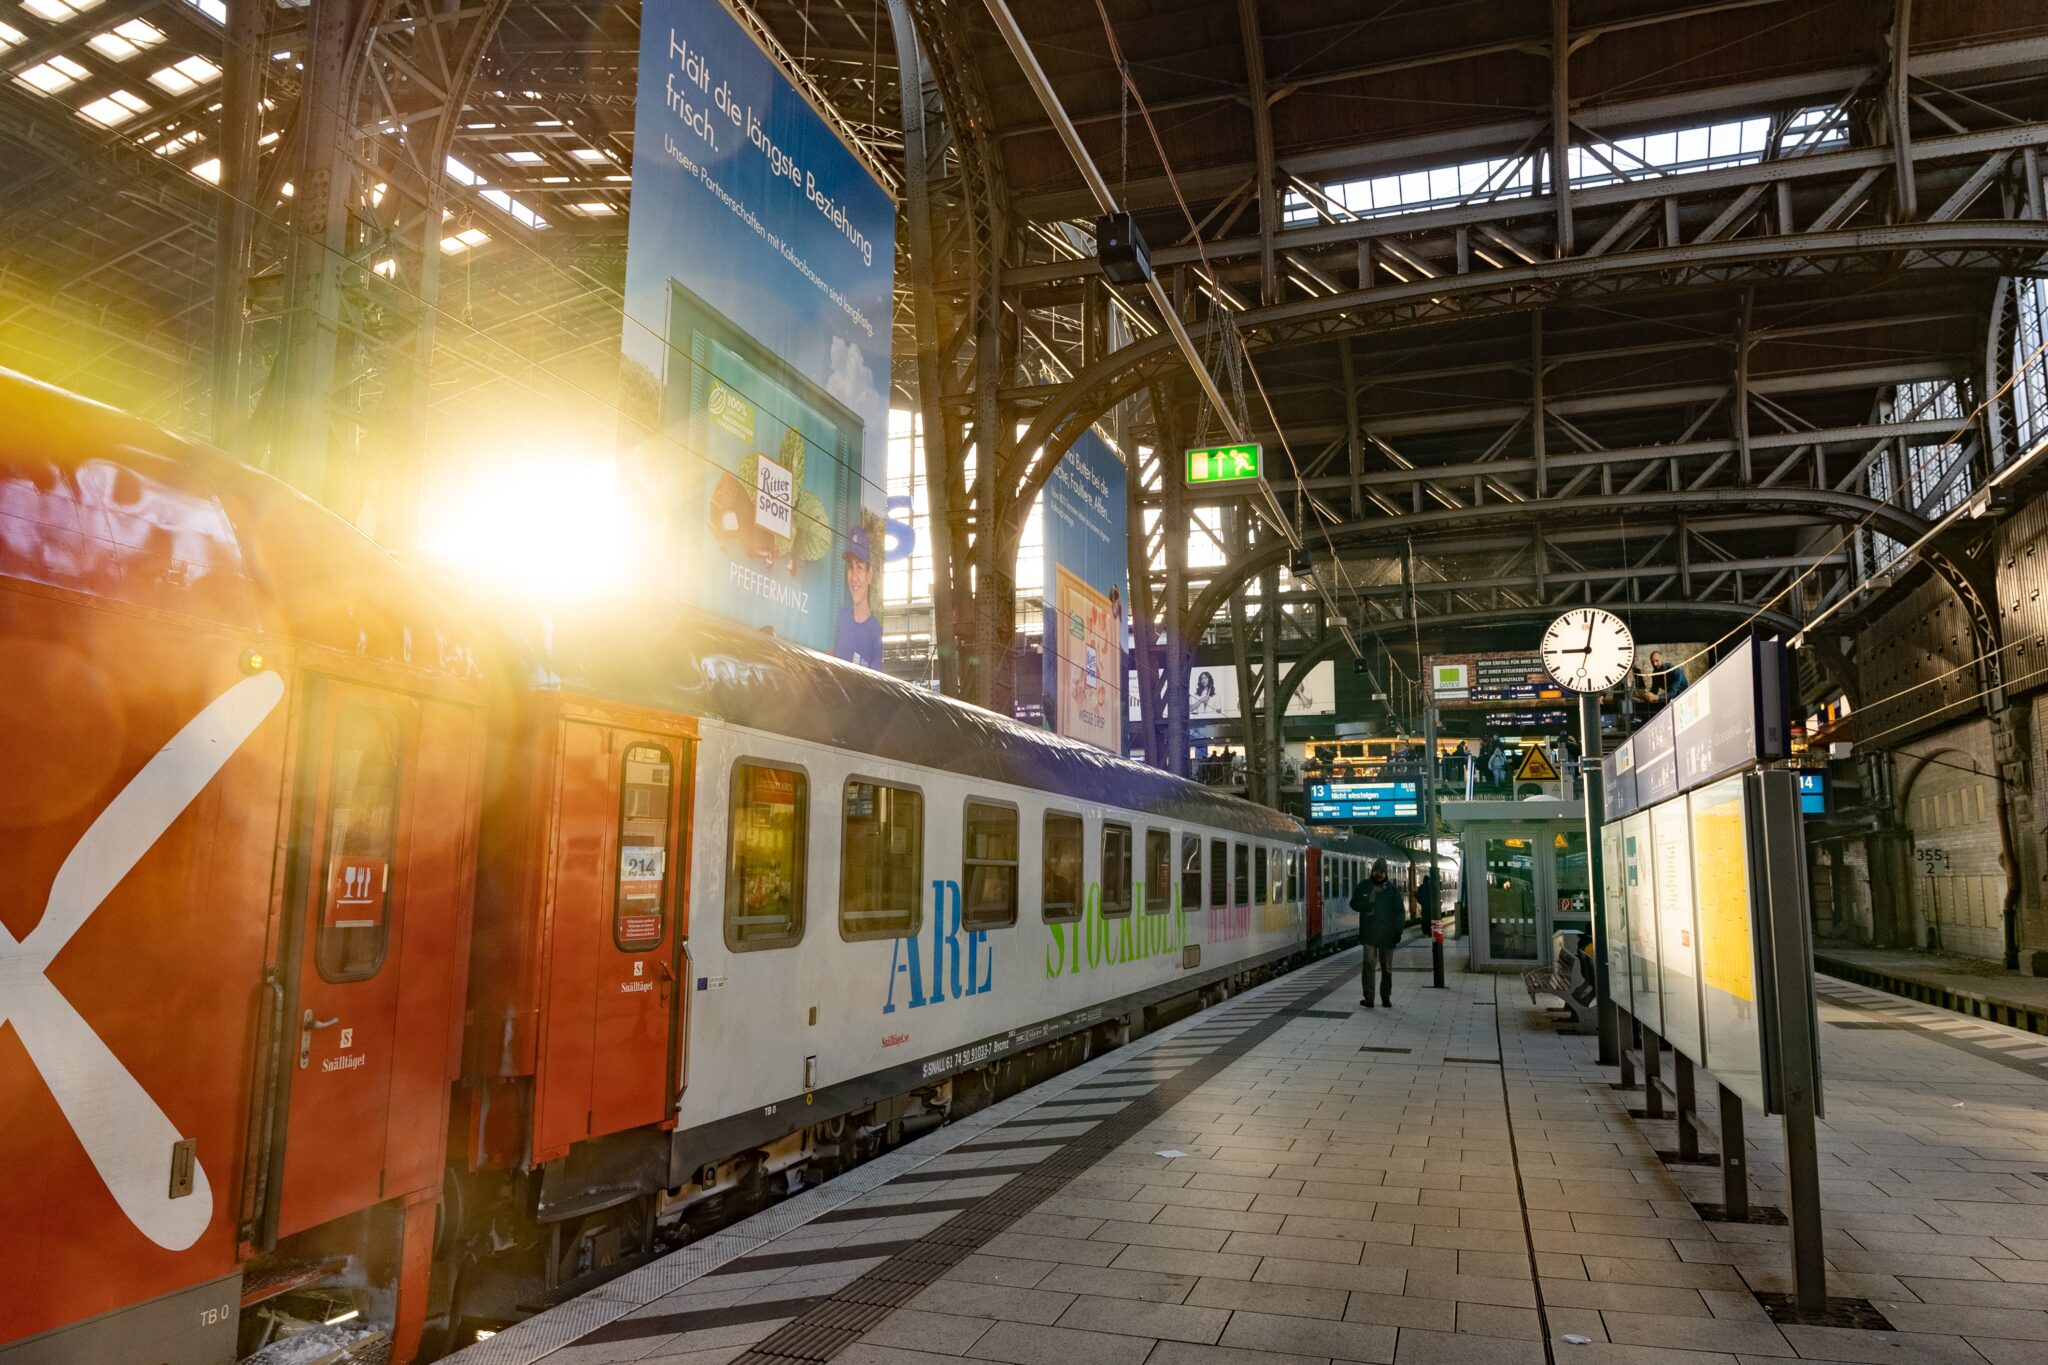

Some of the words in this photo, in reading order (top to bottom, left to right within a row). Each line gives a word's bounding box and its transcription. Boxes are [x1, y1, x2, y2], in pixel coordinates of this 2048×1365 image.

[666, 73, 719, 152] frisch.
[669, 27, 710, 94] Hält
[714, 80, 742, 126] die
[746, 106, 802, 187] längste
[806, 170, 873, 267] Beziehung
[664, 133, 699, 177] Unsere
[701, 167, 766, 239] Partnerschaften
[767, 233, 780, 250] mit
[780, 240, 829, 294] Kakaobauern
[829, 288, 843, 306] sind
[760, 467, 790, 501] Ritter
[759, 495, 790, 522] SPORT
[730, 561, 809, 614] PFEFFERMINZ
[1311, 785, 1325, 797] 13
[1799, 775, 1813, 789] 14
[1348, 792, 1380, 800] einsteigen
[1916, 849, 1943, 861] 355
[629, 858, 656, 877] 214
[1926, 862, 1935, 874] 2
[322, 1053, 366, 1072] Snälltåget
[946, 1055, 953, 1069] 61
[954, 1053, 962, 1066] 74
[963, 1051, 971, 1063] 50
[765, 1106, 772, 1116] TB
[200, 1308, 217, 1326] TB
[221, 1304, 229, 1320] 0
